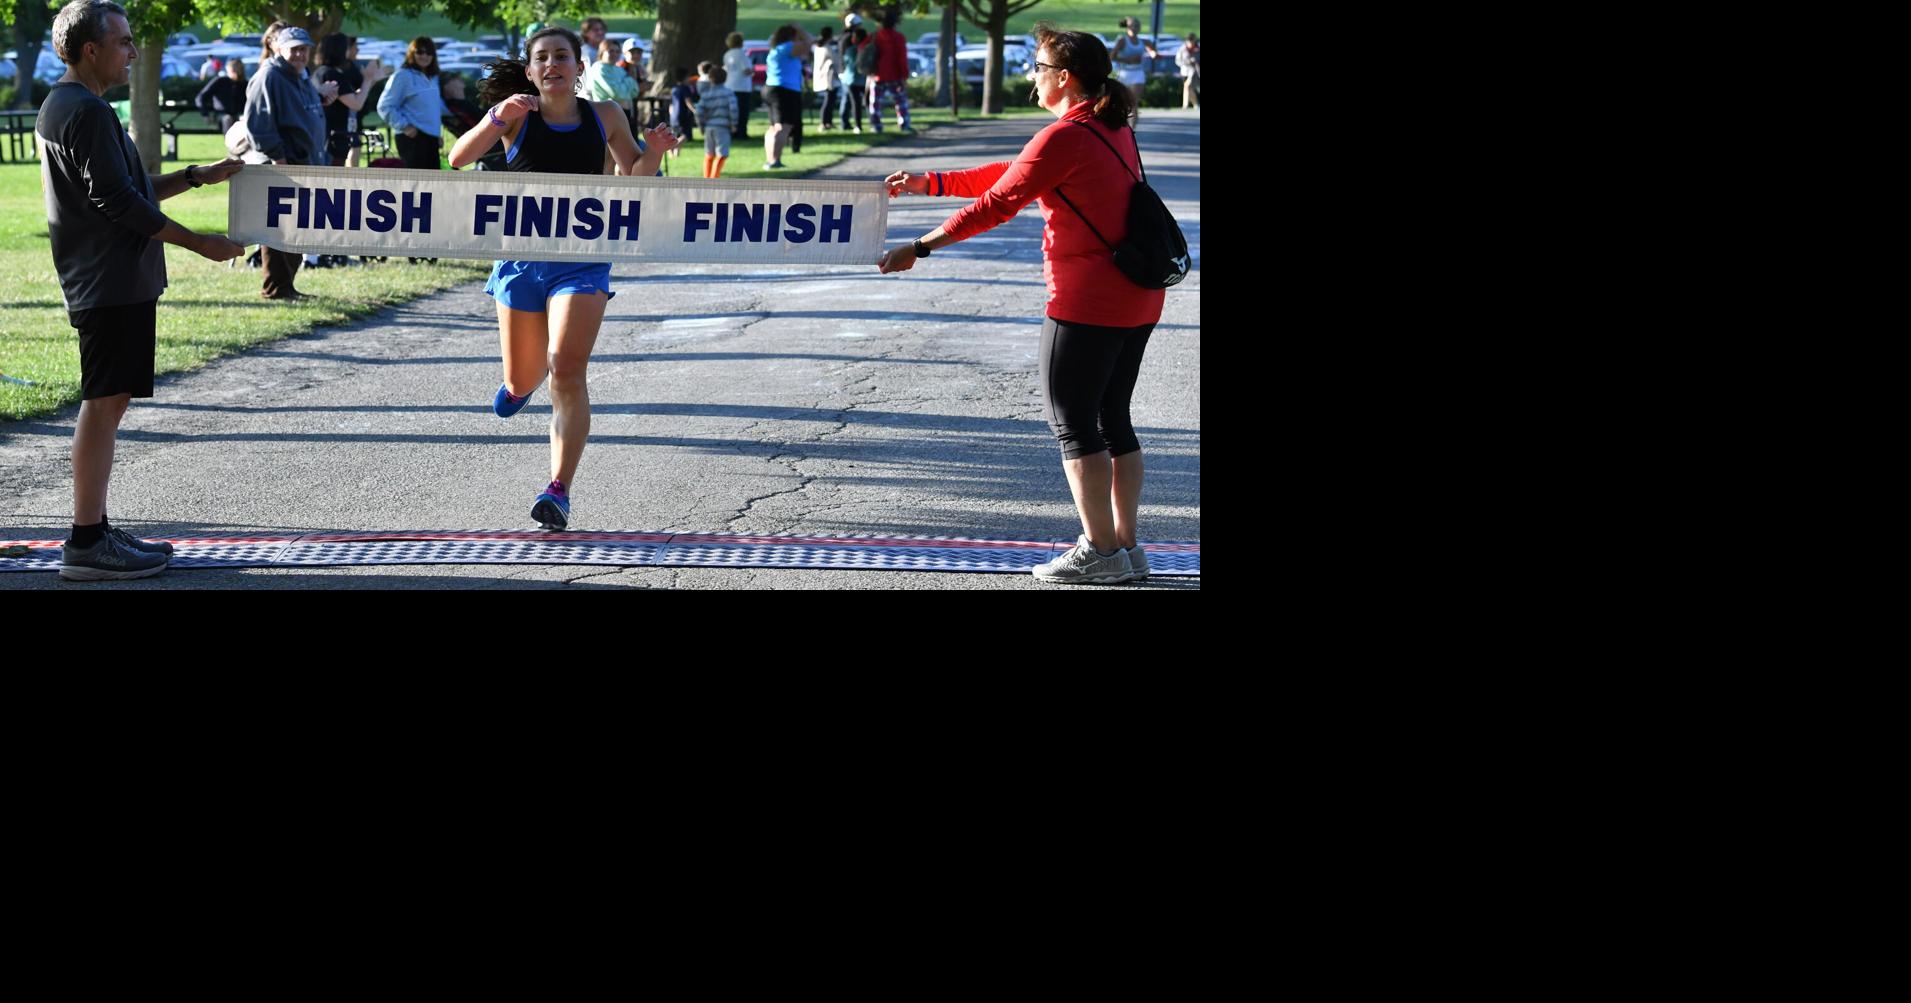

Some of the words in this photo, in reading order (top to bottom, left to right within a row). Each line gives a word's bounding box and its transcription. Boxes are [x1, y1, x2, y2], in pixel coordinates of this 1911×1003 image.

[267, 187, 432, 234] FINISH
[474, 195, 641, 241] FINISH
[683, 203, 853, 243] FINISH
